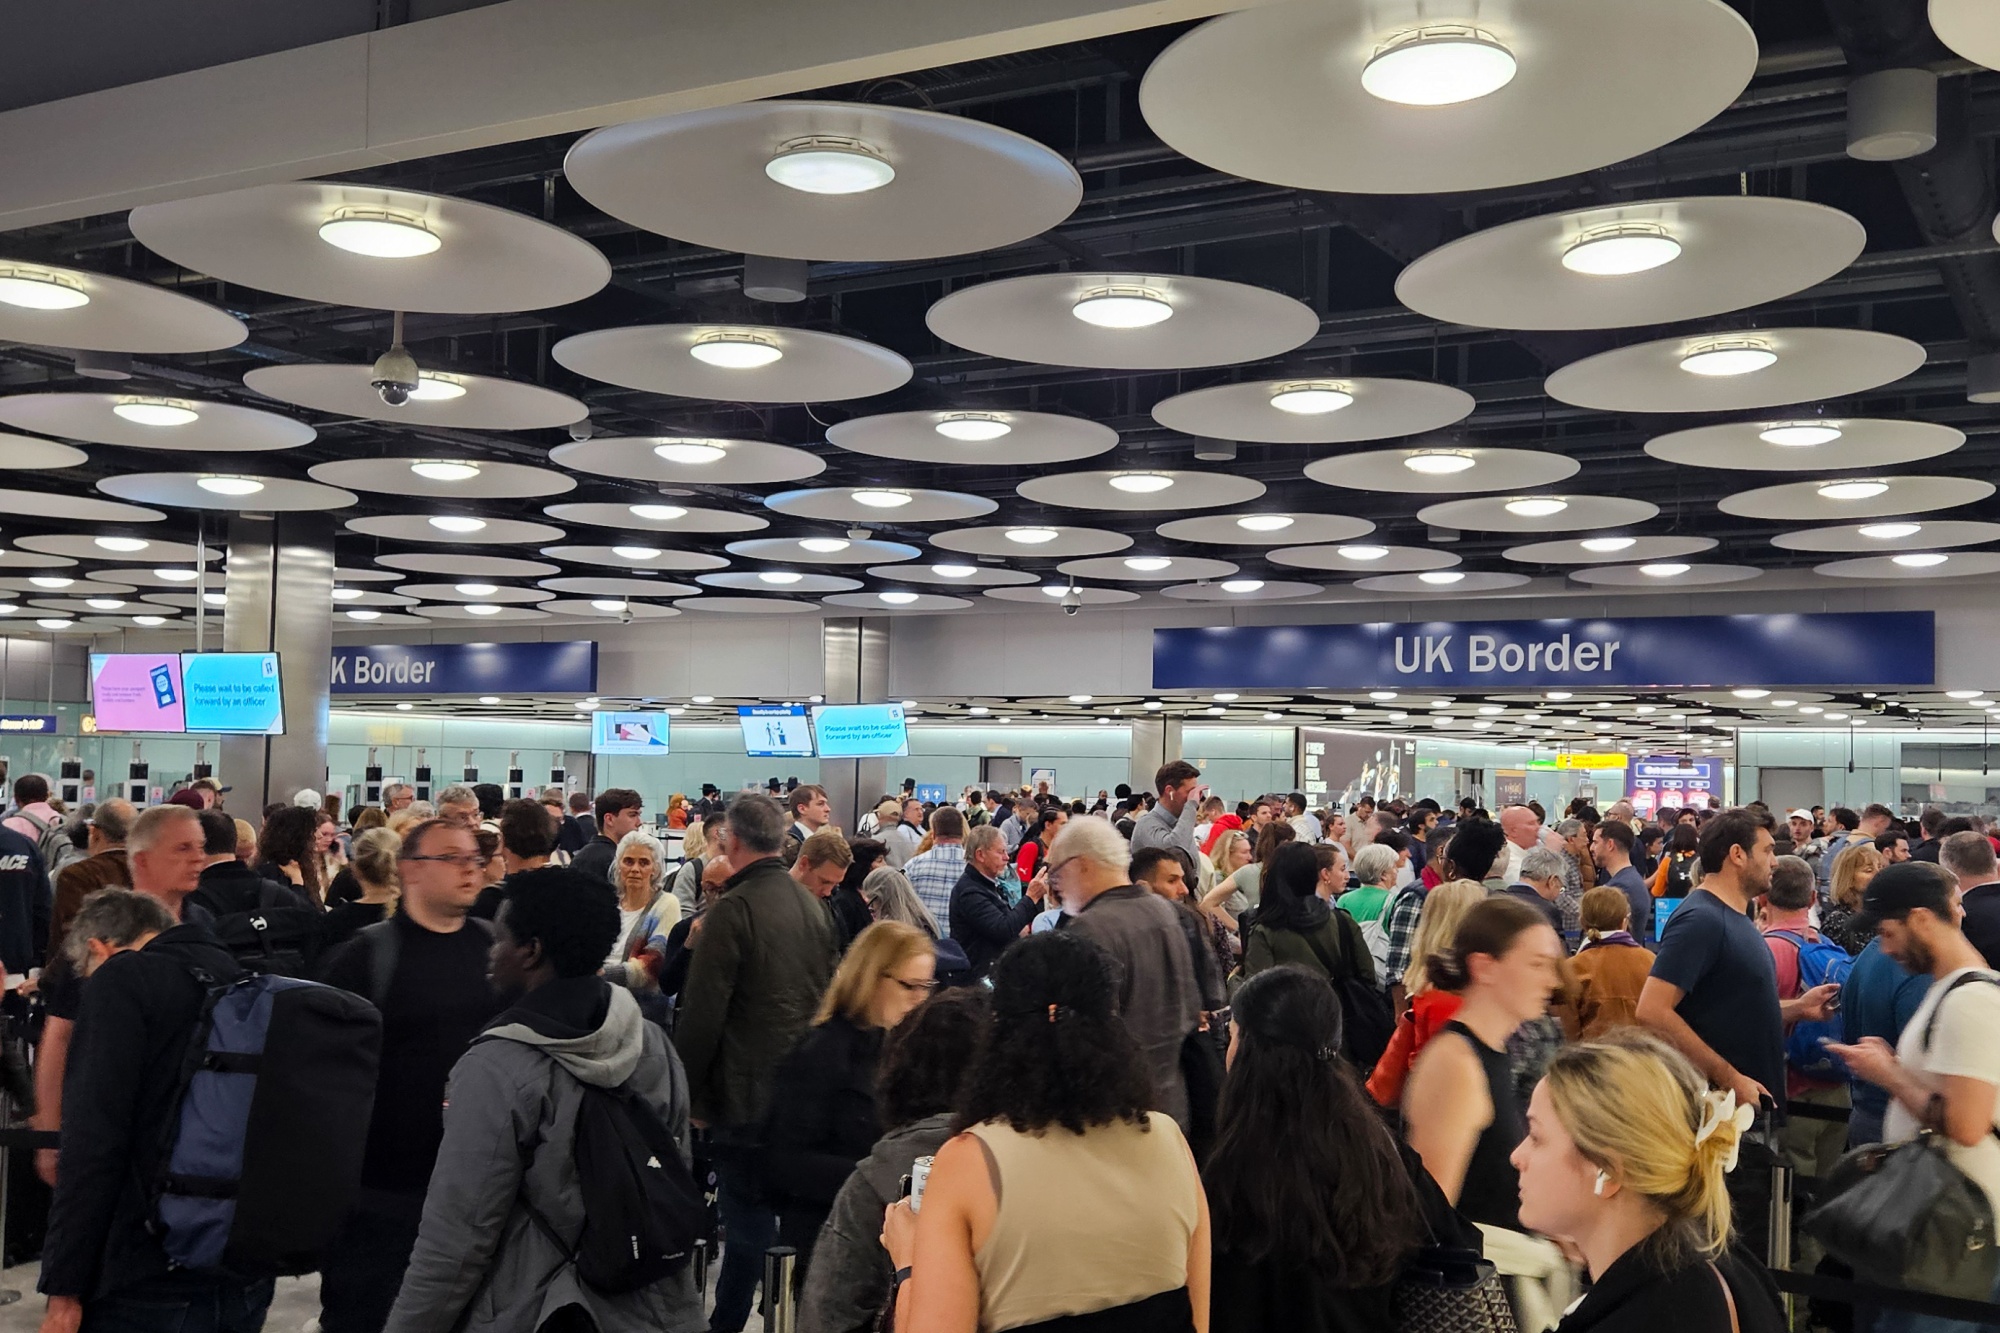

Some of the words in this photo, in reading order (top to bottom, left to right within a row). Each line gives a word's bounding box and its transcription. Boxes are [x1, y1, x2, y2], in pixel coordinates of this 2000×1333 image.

[1395, 635, 1453, 673] UK
[1469, 633, 1620, 672] Border
[330, 656, 347, 684] K
[354, 655, 435, 684] Border
[193, 683, 217, 693] Please
[218, 684, 232, 693] wait
[233, 684, 241, 693] to
[242, 683, 251, 693] be
[253, 683, 275, 693] called
[194, 697, 221, 706] forward
[222, 697, 231, 708] by
[243, 697, 266, 707] officer
[870, 723, 879, 731] be
[880, 723, 901, 731] called
[852, 733, 861, 741] by
